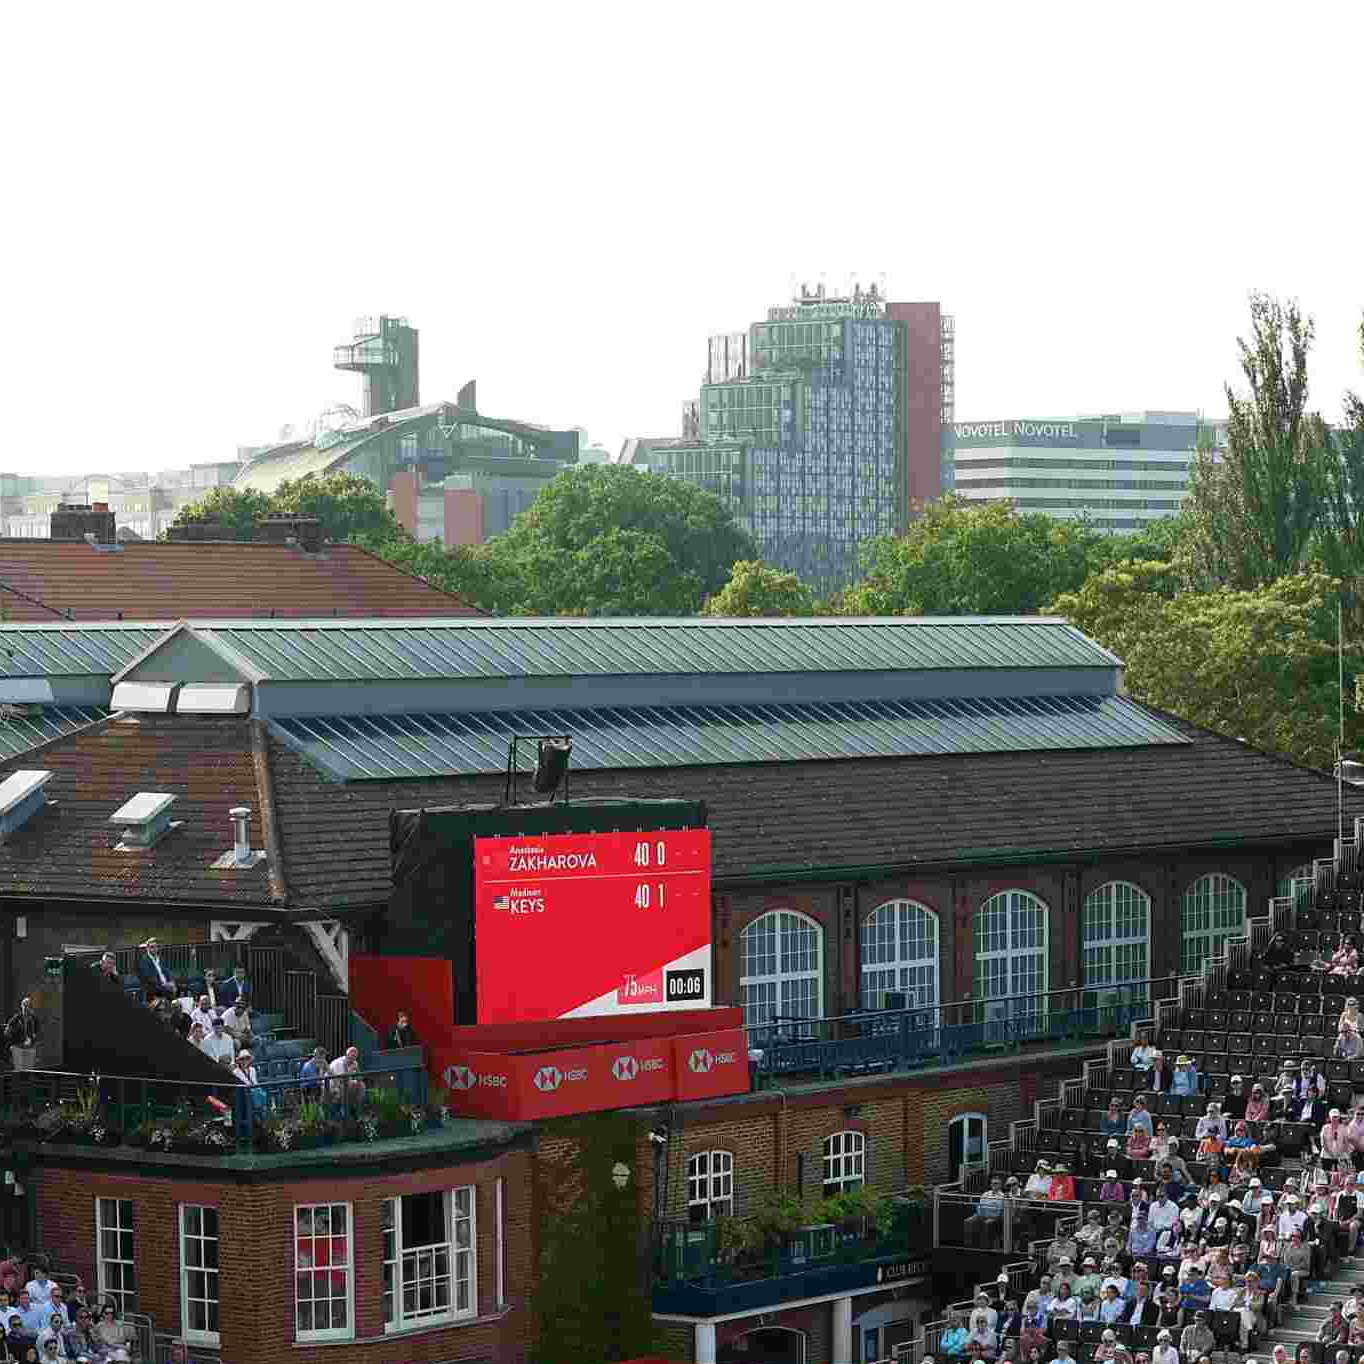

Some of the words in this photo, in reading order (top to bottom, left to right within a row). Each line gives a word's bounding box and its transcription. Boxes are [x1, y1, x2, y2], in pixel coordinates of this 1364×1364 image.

[954, 423, 1008, 438] NOVOTEL
[1013, 422, 1078, 438] NOVOTEL
[509, 853, 597, 872] ZAKHAROVA
[634, 841, 649, 866] 40
[657, 841, 665, 866] 0
[509, 898, 545, 914] KEYS
[635, 883, 649, 908] 40
[658, 883, 664, 908] 1
[669, 977, 701, 995] 00:06
[478, 1074, 508, 1087] HSBC
